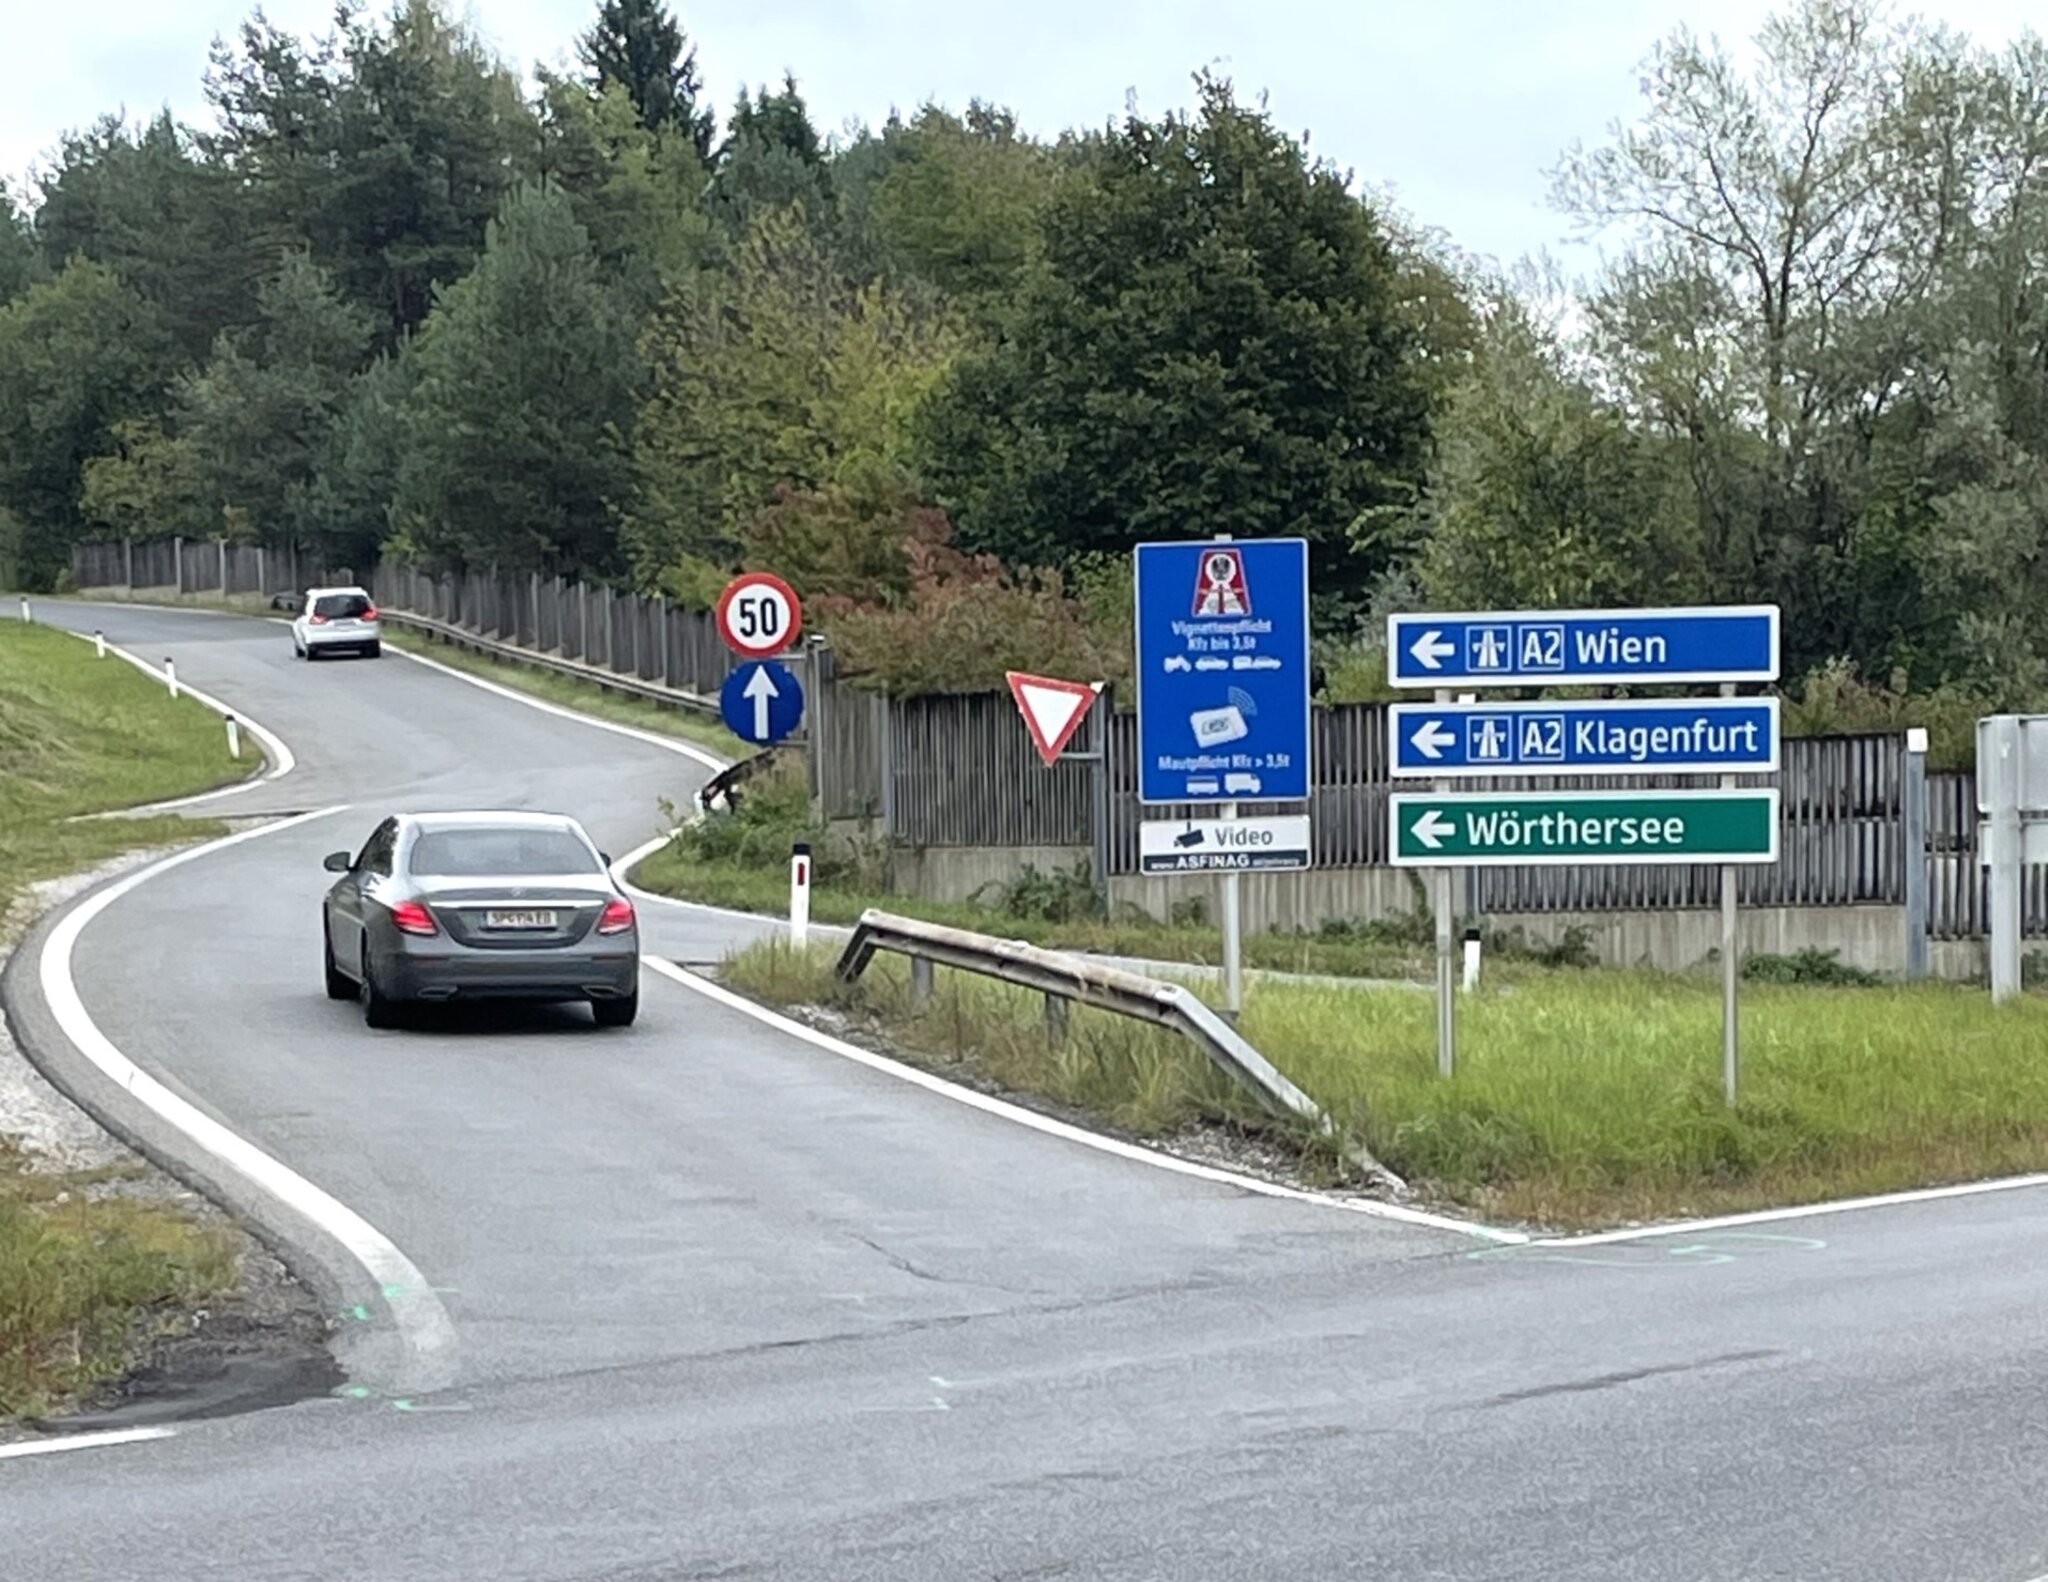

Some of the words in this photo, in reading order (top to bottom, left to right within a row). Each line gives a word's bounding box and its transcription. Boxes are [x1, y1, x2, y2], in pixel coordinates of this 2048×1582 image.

[739, 597, 778, 638] 50
[1522, 630, 1562, 665] A2
[1575, 627, 1666, 664] Wien
[1522, 720, 1562, 756] A2
[1575, 718, 1758, 761] Klagenfurt
[1215, 826, 1273, 847] Video
[1466, 811, 1685, 846] Wörthersee
[1176, 854, 1250, 870] ASFINAG
